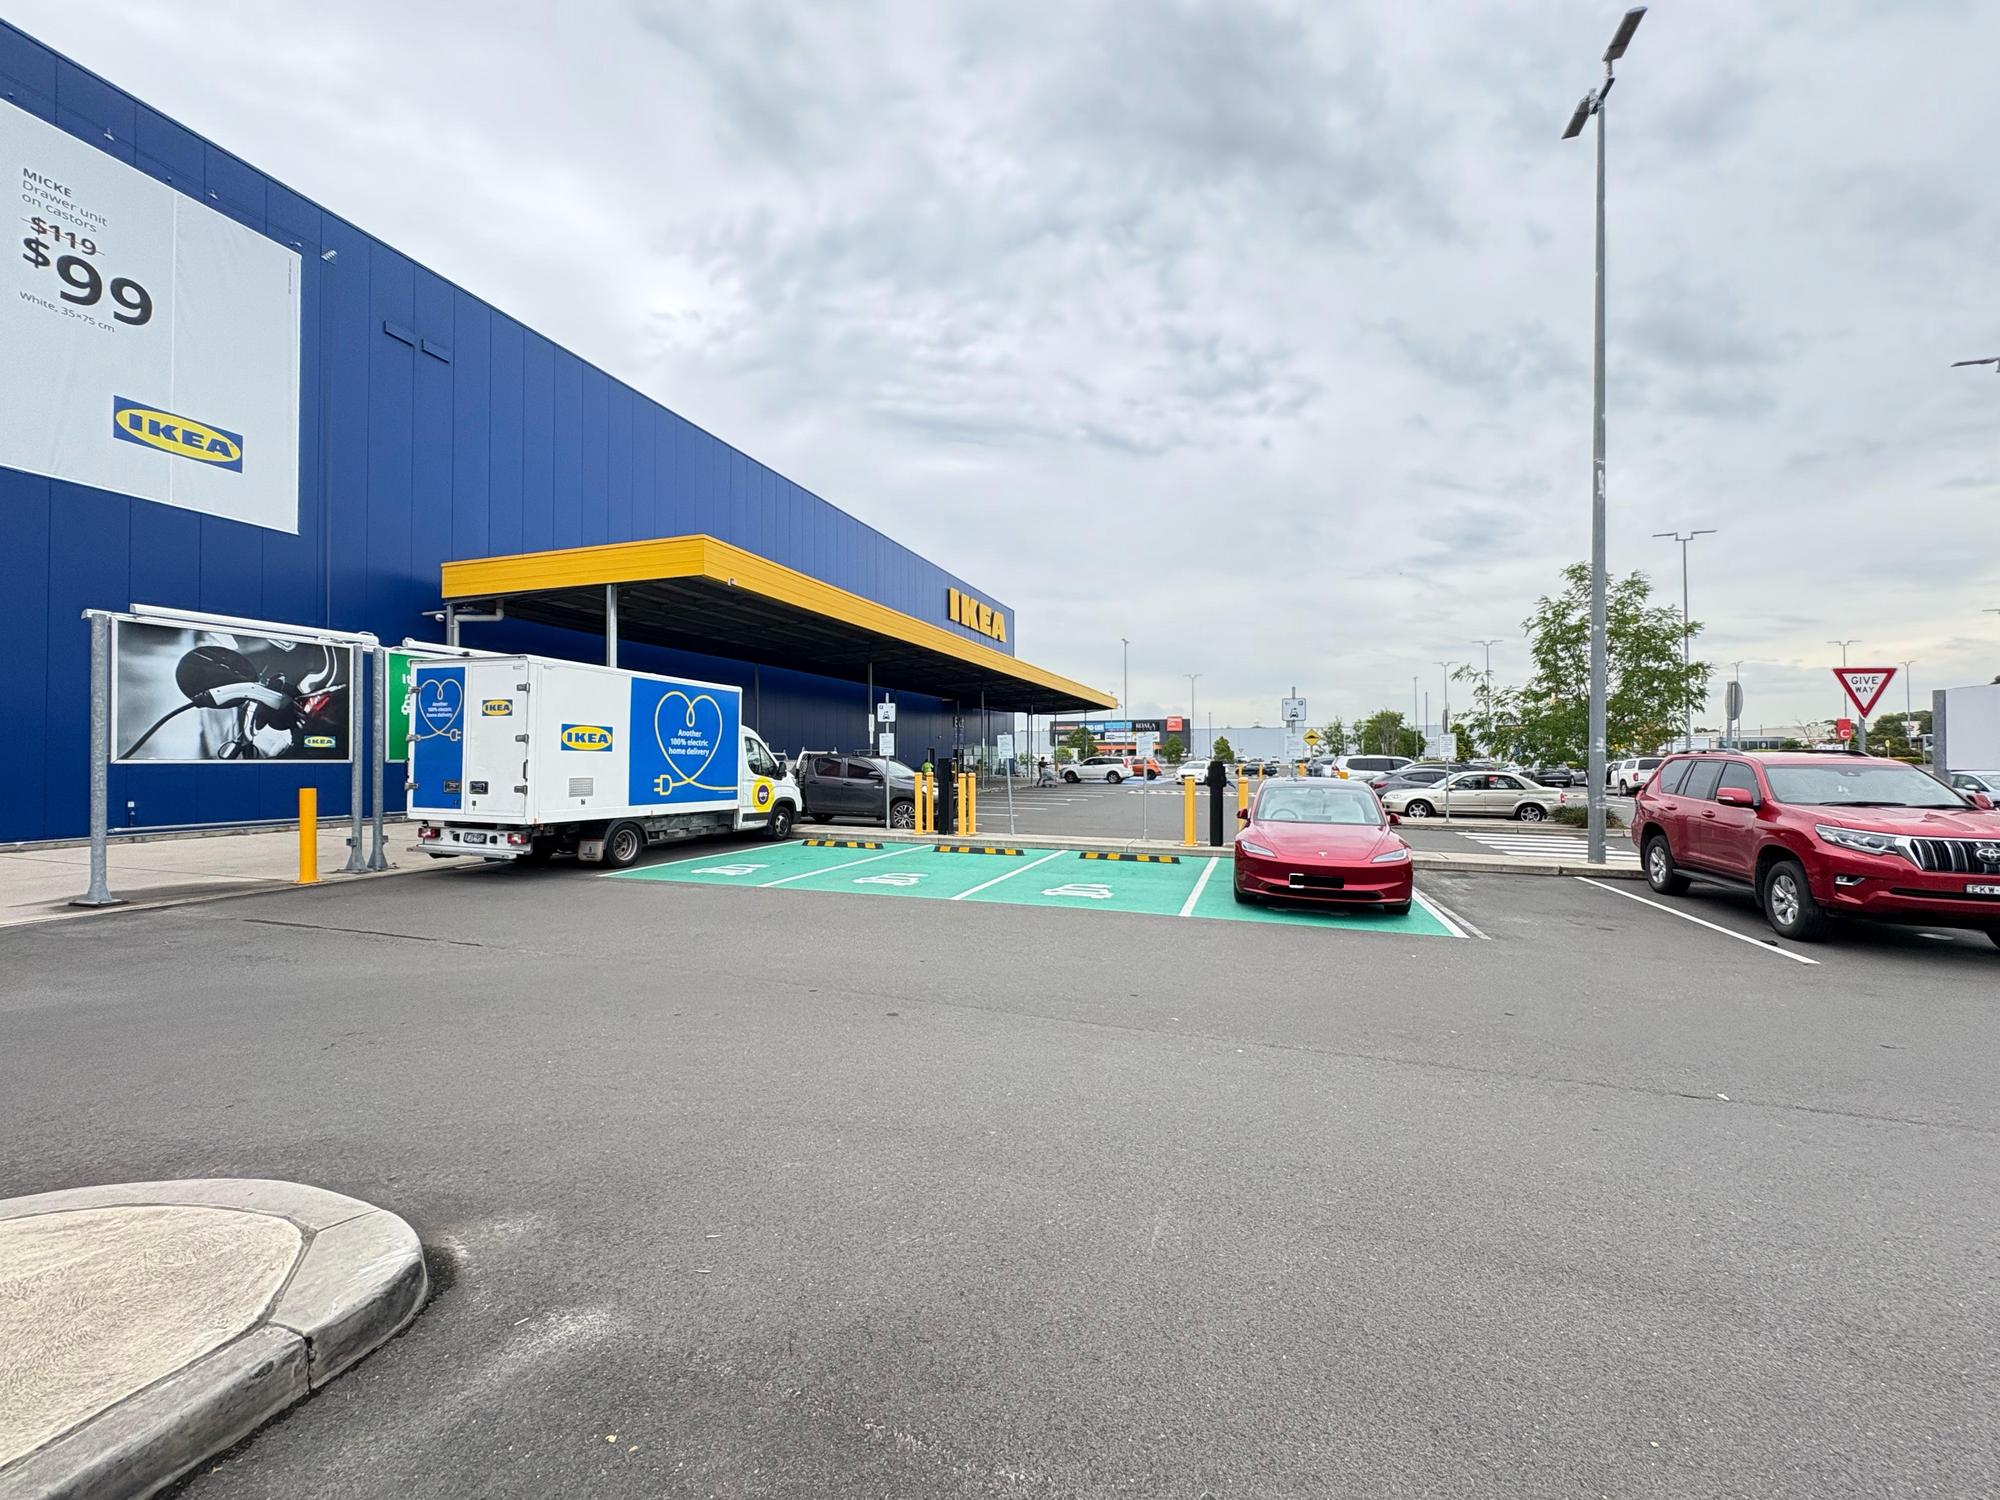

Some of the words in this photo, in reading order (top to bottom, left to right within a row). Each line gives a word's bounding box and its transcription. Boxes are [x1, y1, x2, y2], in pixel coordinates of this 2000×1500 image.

[23, 167, 73, 198] MICKE
[21, 193, 42, 208] on
[45, 204, 97, 233] castors
[22, 180, 77, 210] Drawer
[79, 209, 109, 227] unit
[31, 216, 97, 256] $119
[22, 237, 153, 326] $99
[97, 321, 116, 333] cm
[129, 412, 233, 459] IKEA
[947, 587, 1008, 644] IKEA
[1850, 676, 1879, 685] GIVE
[566, 732, 609, 744] IKEA
[670, 738, 686, 746] 100%
[687, 738, 709, 747] electric
[677, 728, 702, 738] Another
[1839, 729, 1850, 738] C
[668, 747, 685, 755] home
[686, 747, 710, 757] delivery
